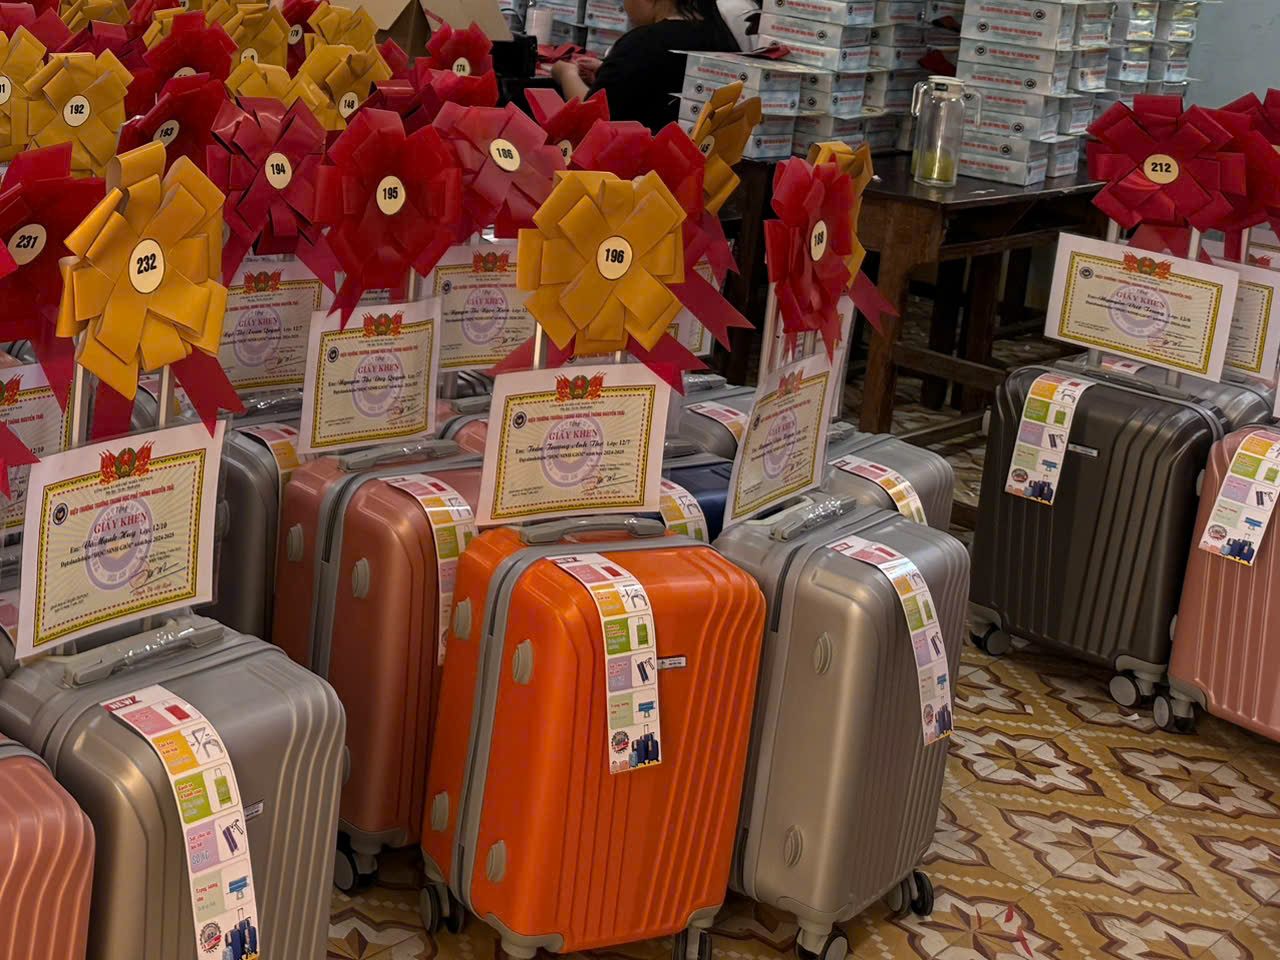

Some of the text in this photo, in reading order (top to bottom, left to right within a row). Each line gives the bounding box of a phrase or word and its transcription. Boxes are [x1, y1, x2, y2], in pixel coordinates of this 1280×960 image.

[69, 103, 85, 115] 192
[342, 98, 357, 110] 148
[159, 126, 175, 139] 193
[496, 147, 514, 161] 186
[270, 162, 286, 176] 194
[1151, 162, 1172, 174] 212
[382, 186, 399, 201] 195
[15, 234, 40, 250] 231
[605, 247, 625, 264] 196
[136, 252, 157, 275] 232
[120, 511, 146, 527] KHEN
[152, 521, 167, 531] 12/10
[110, 696, 133, 710] NEW
